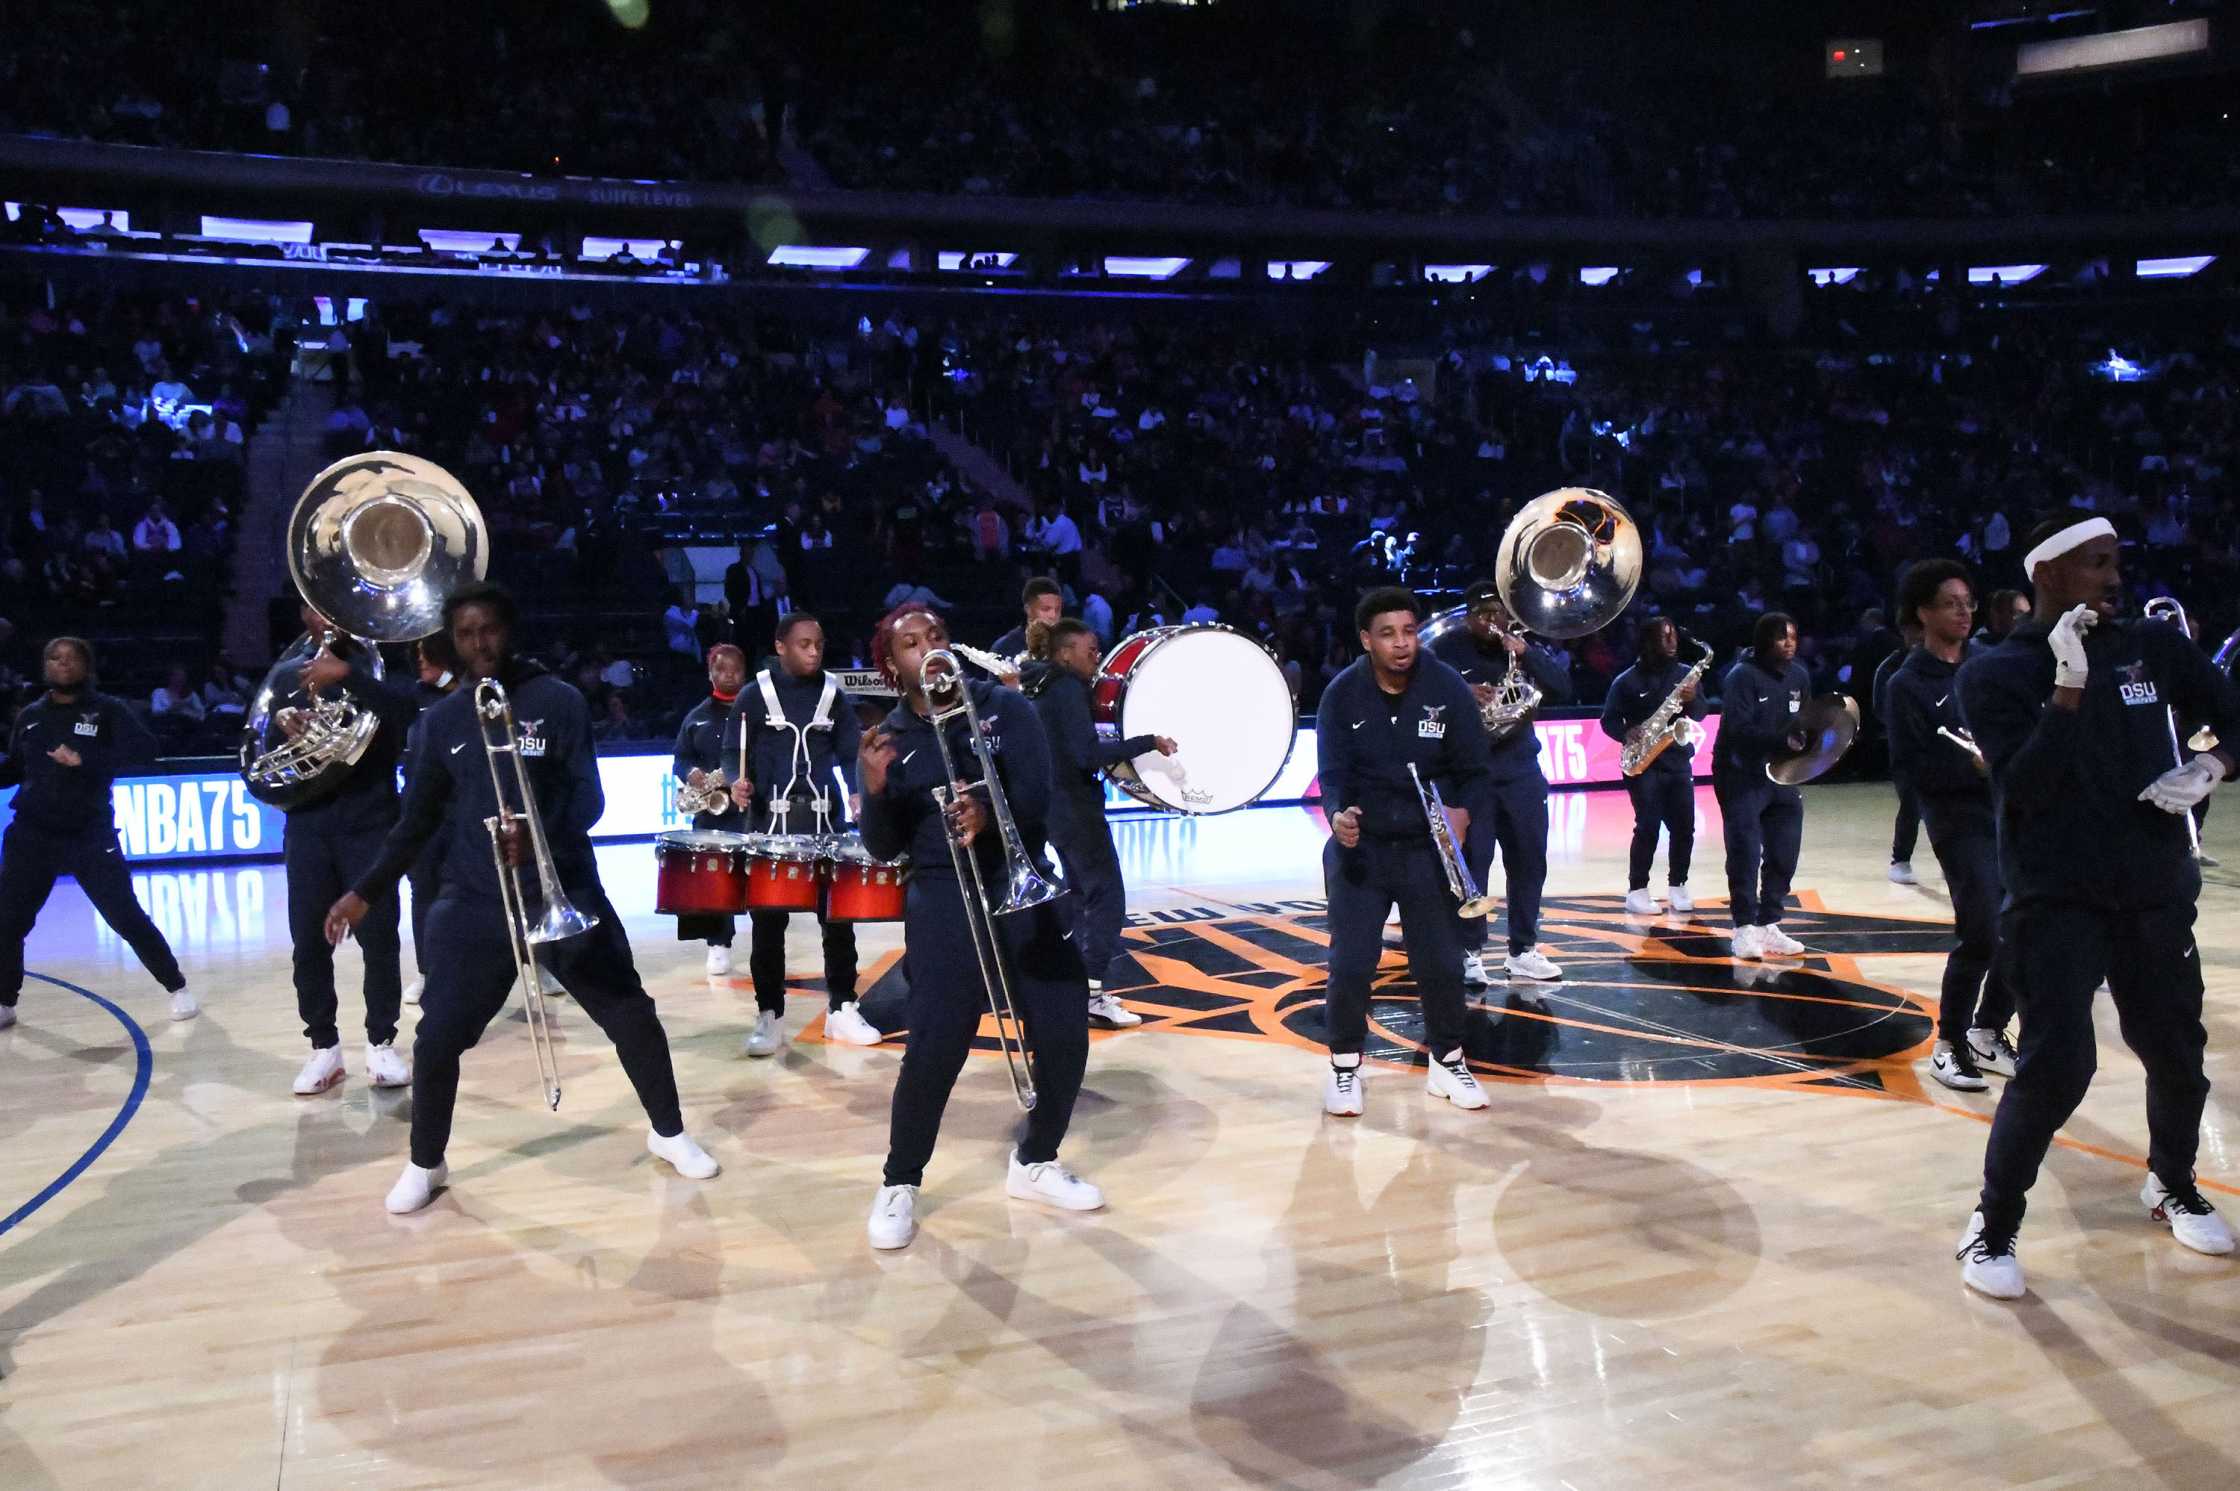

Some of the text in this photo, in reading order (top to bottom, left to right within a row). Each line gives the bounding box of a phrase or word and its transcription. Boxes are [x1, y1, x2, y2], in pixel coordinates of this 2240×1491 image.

[843, 674, 885, 687] Wilso
[2119, 680, 2158, 700] DSU
[1418, 719, 1446, 734] DSU
[112, 779, 262, 856] NBA75
[1123, 906, 1226, 927] EW
